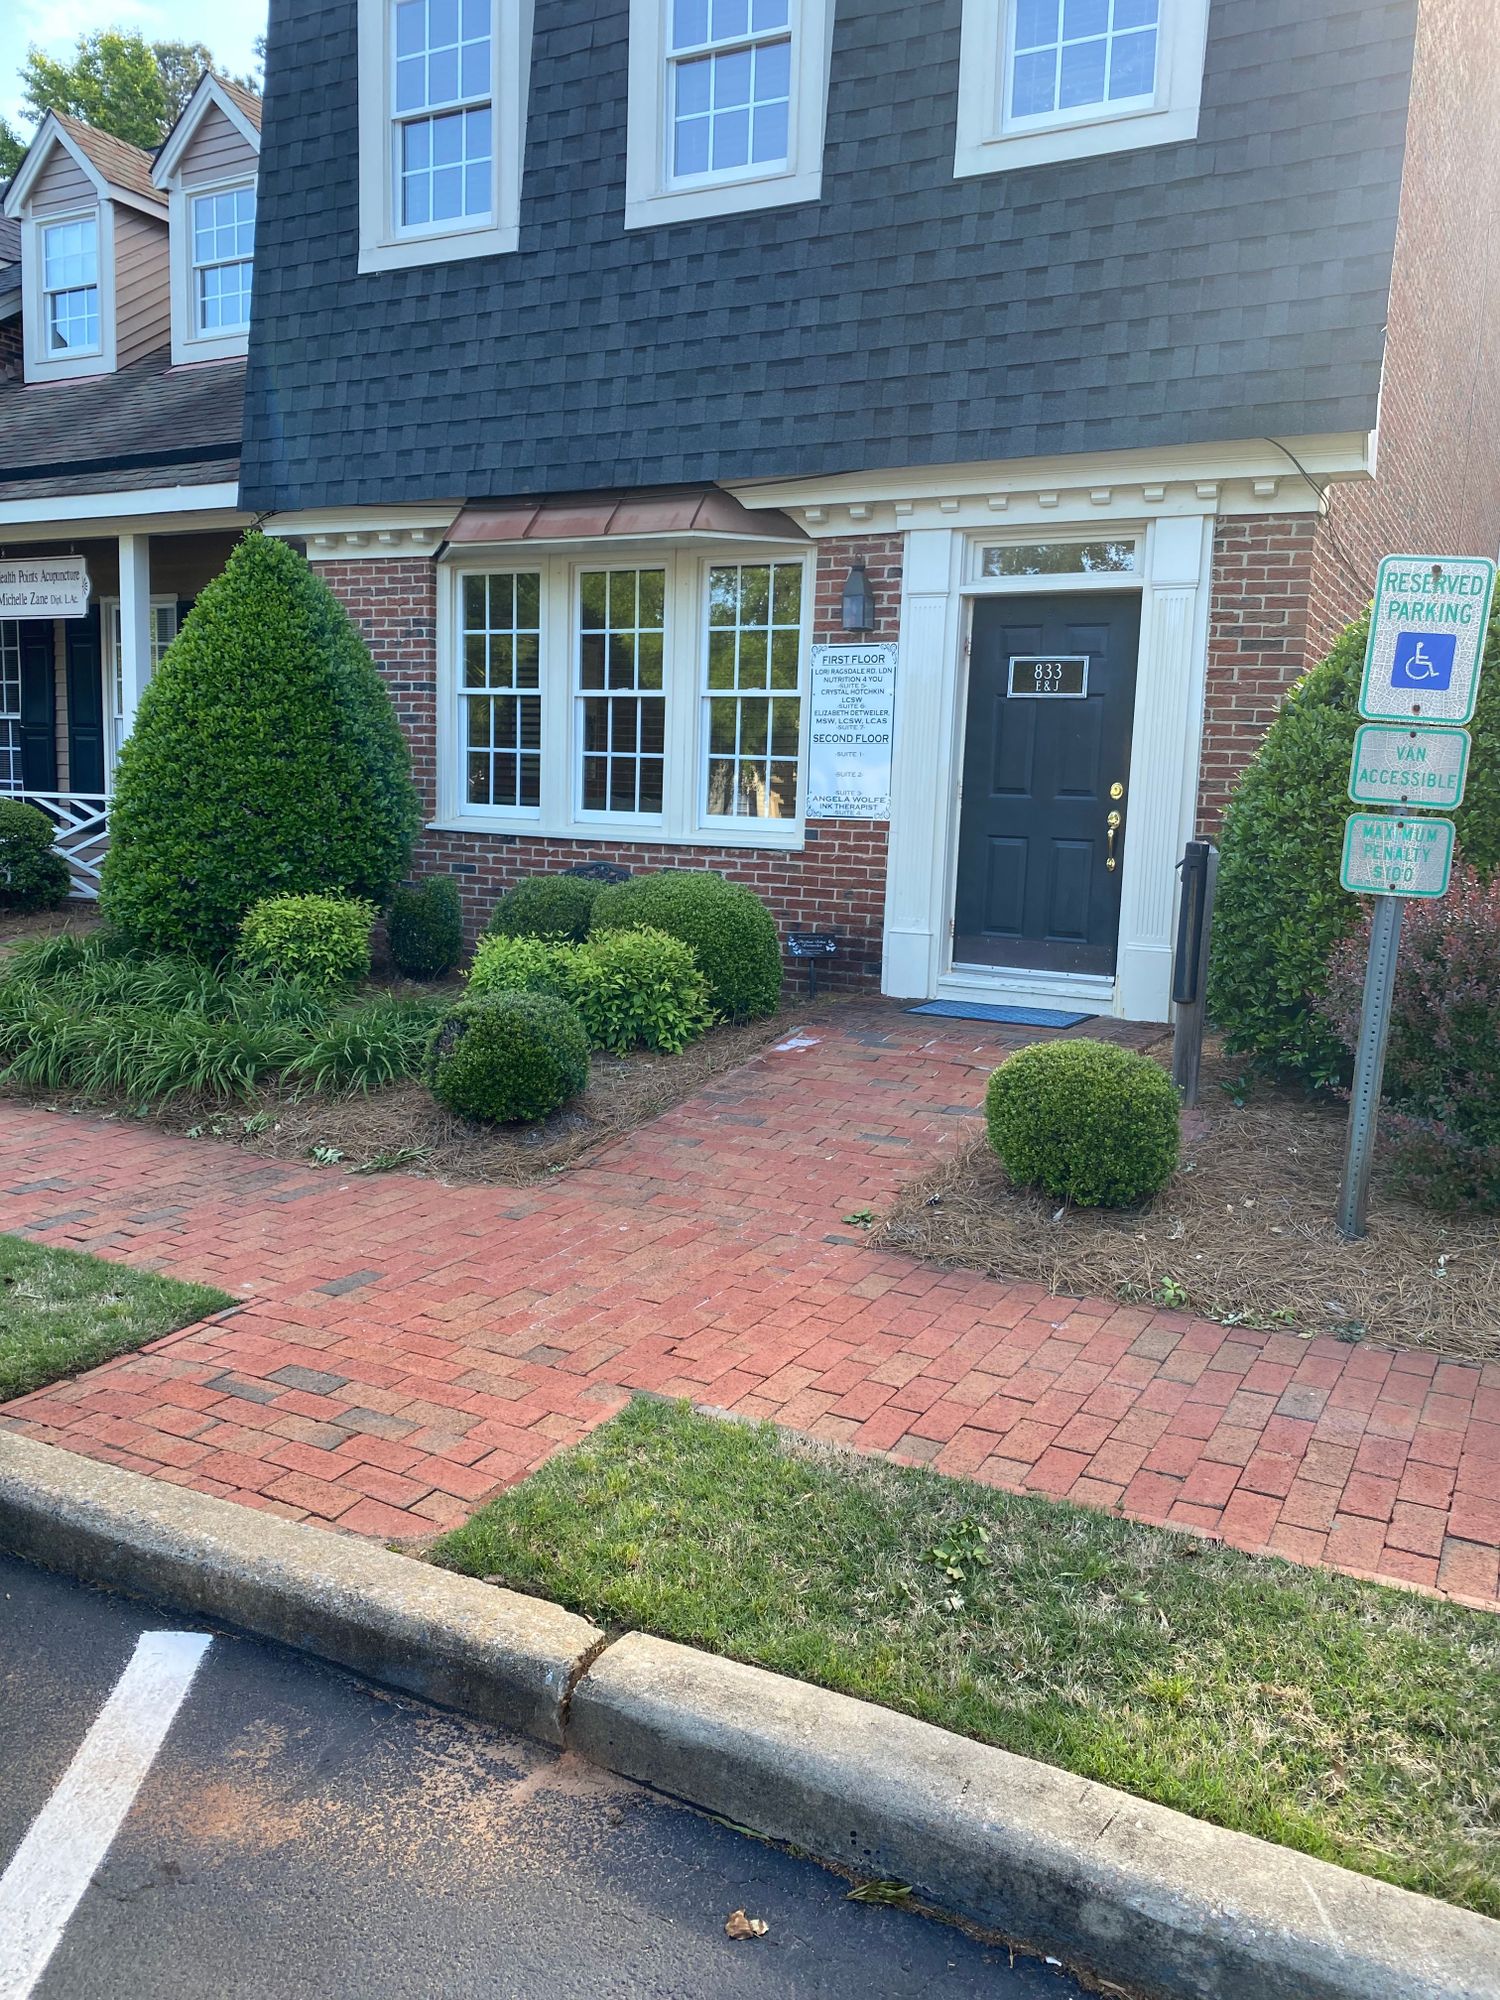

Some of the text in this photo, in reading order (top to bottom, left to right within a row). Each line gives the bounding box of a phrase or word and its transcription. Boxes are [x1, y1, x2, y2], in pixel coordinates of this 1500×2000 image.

[0, 570, 80, 584] ealth Points Acupuncture
[1384, 572, 1484, 596] RESERVED
[0, 593, 28, 606] Michelle
[30, 592, 48, 605] Zane
[1388, 600, 1473, 624] PARKING
[822, 655, 885, 665] FIRST FLOOR
[1034, 663, 1062, 679] 833
[1035, 680, 1059, 691] E & J
[813, 734, 889, 743] SECOND FLOOR
[1396, 746, 1428, 762] VAN
[1359, 768, 1457, 789] ACCESSIBLE
[1362, 824, 1438, 843] MAXIMUM
[1362, 844, 1432, 862] PENALTY
[1372, 865, 1413, 882] $100
